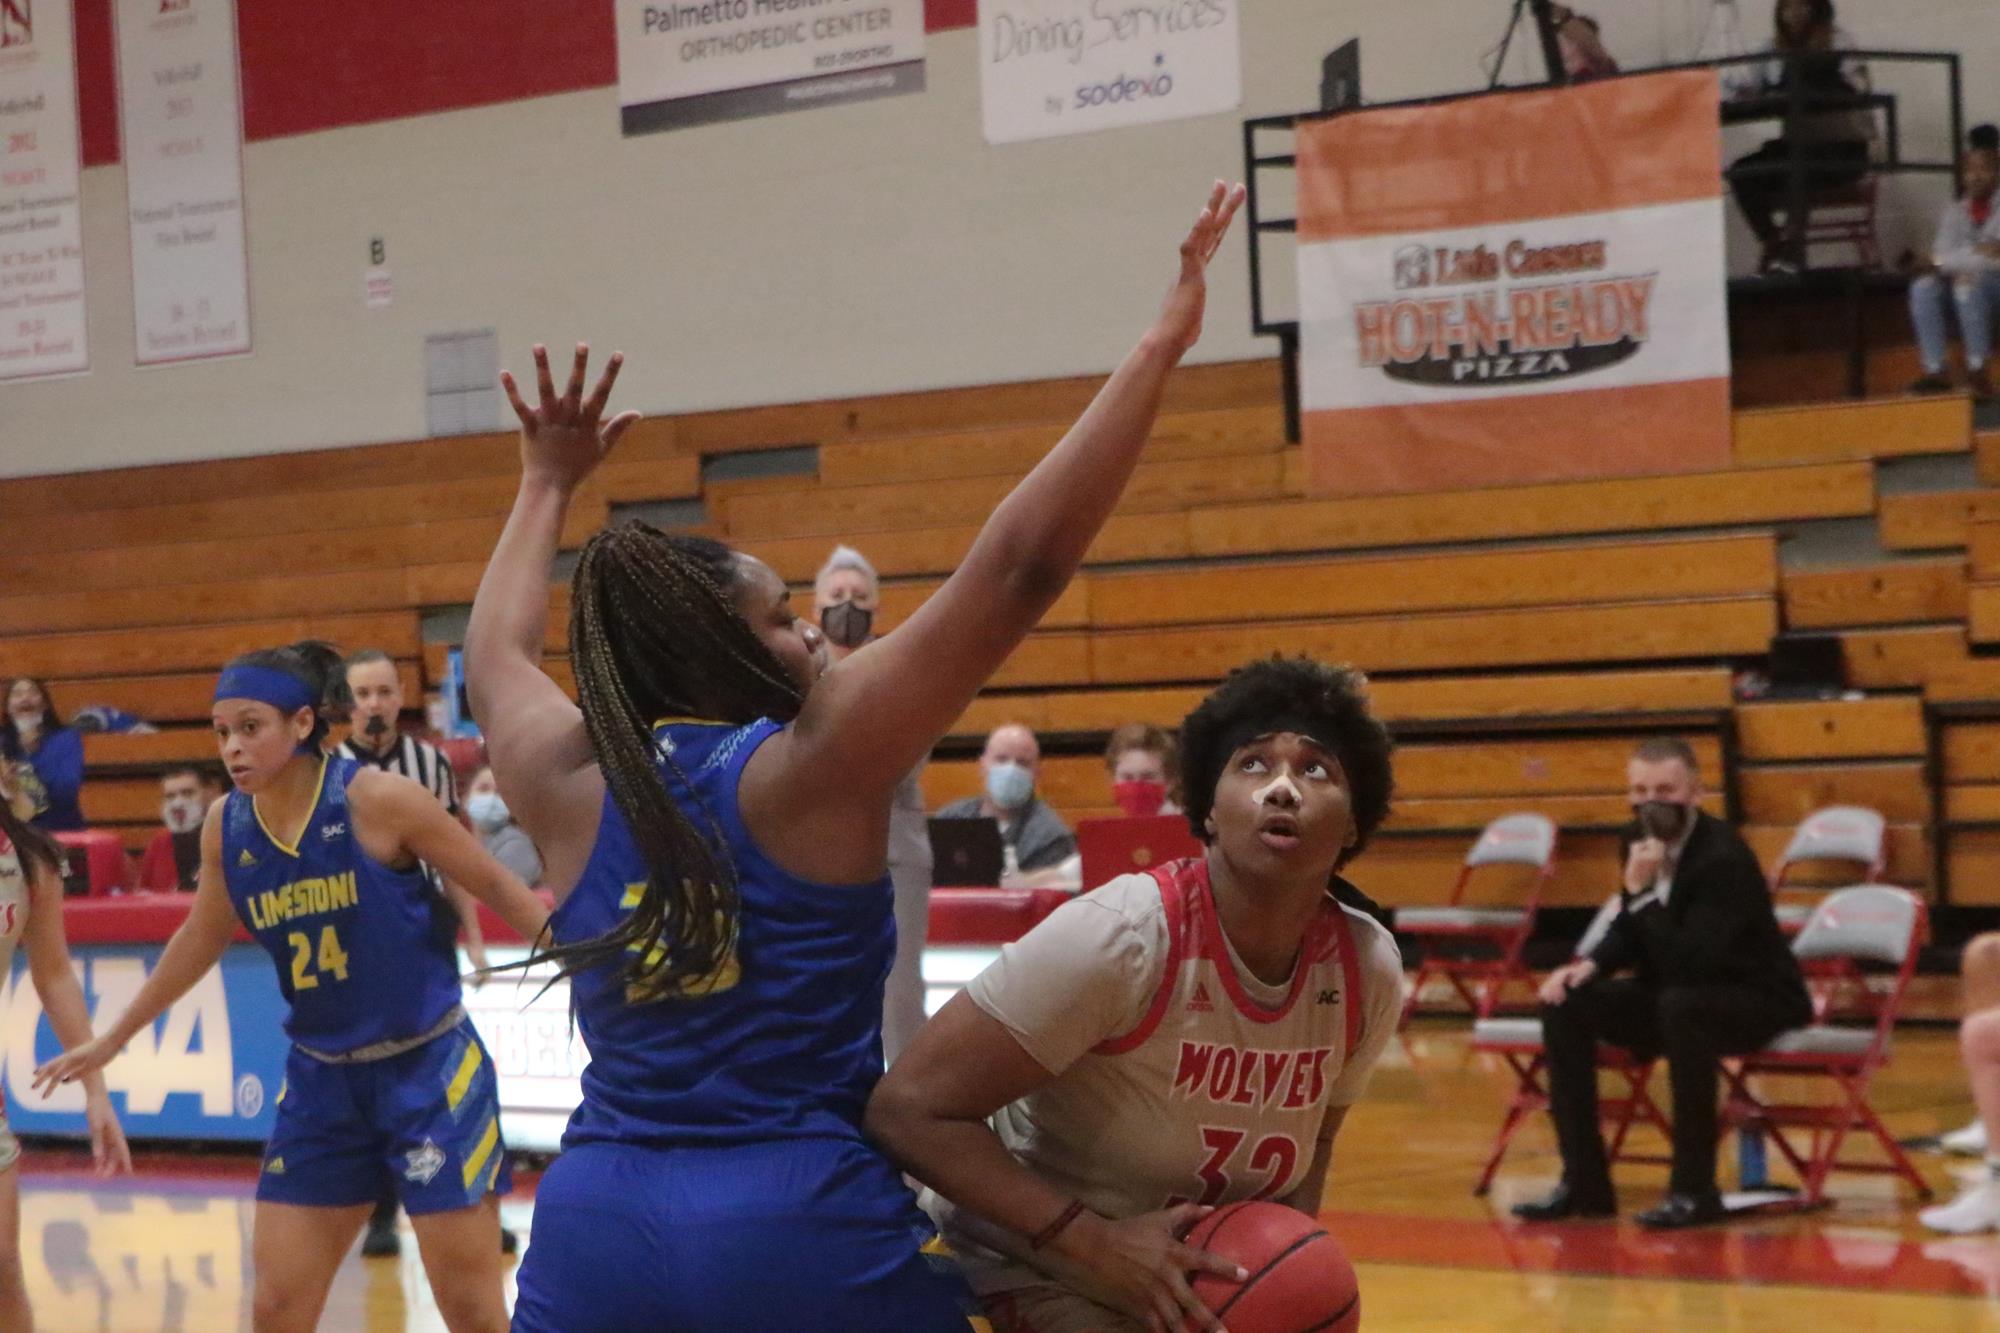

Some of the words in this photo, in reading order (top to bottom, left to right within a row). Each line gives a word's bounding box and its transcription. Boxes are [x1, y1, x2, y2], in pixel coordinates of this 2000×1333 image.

[643, 1, 748, 34] Palmetto
[679, 22, 805, 63] ORTHOPEDIC
[813, 7, 892, 41] CENTER
[992, 15, 1083, 65] Dining
[1084, 0, 1226, 48] Services
[1074, 74, 1173, 109] sodexo
[1354, 274, 1659, 367] HOT-N-READY
[1453, 351, 1569, 381] PIZZA
[288, 925, 349, 990] 24
[1316, 989, 1340, 1005] AC
[0, 957, 235, 1117] CAA
[1164, 1124, 1298, 1206] 32
